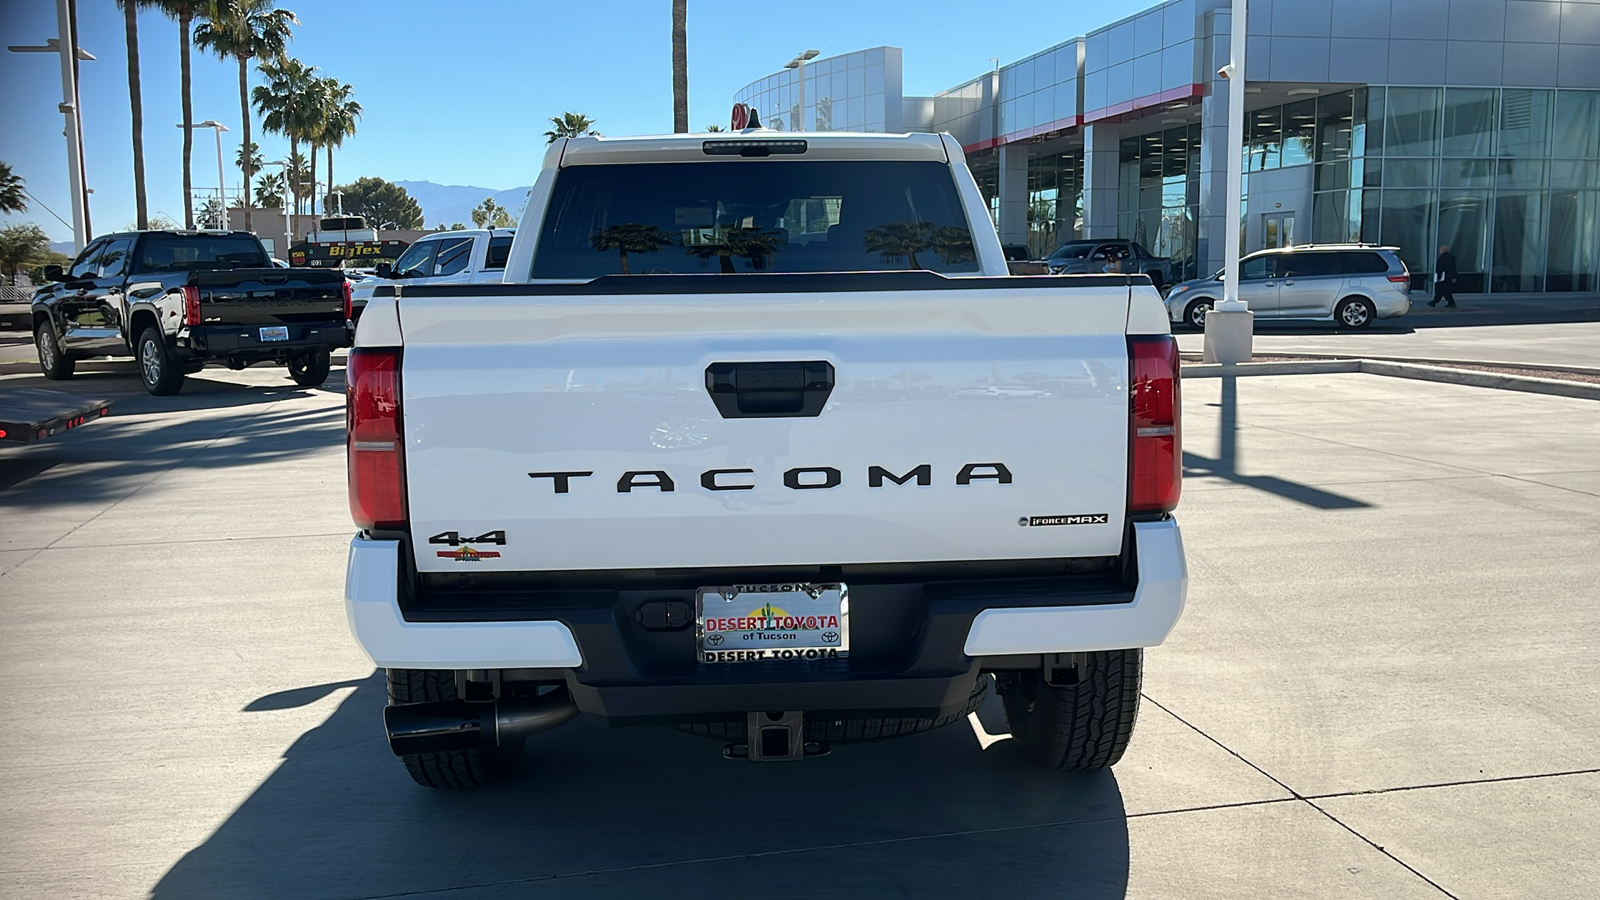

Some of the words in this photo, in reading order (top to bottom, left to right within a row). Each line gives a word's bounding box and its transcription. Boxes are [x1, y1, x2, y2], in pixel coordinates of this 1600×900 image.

[329, 245, 381, 257] BigTex
[527, 463, 1013, 494] TACOMA
[735, 583, 808, 593] TUCSON
[706, 616, 768, 632] DESERT
[772, 615, 839, 630] TOYOTA
[742, 632, 754, 640] of
[756, 632, 797, 640] Tucson
[705, 651, 767, 663] DESERT
[772, 648, 839, 660] TOYOTA
